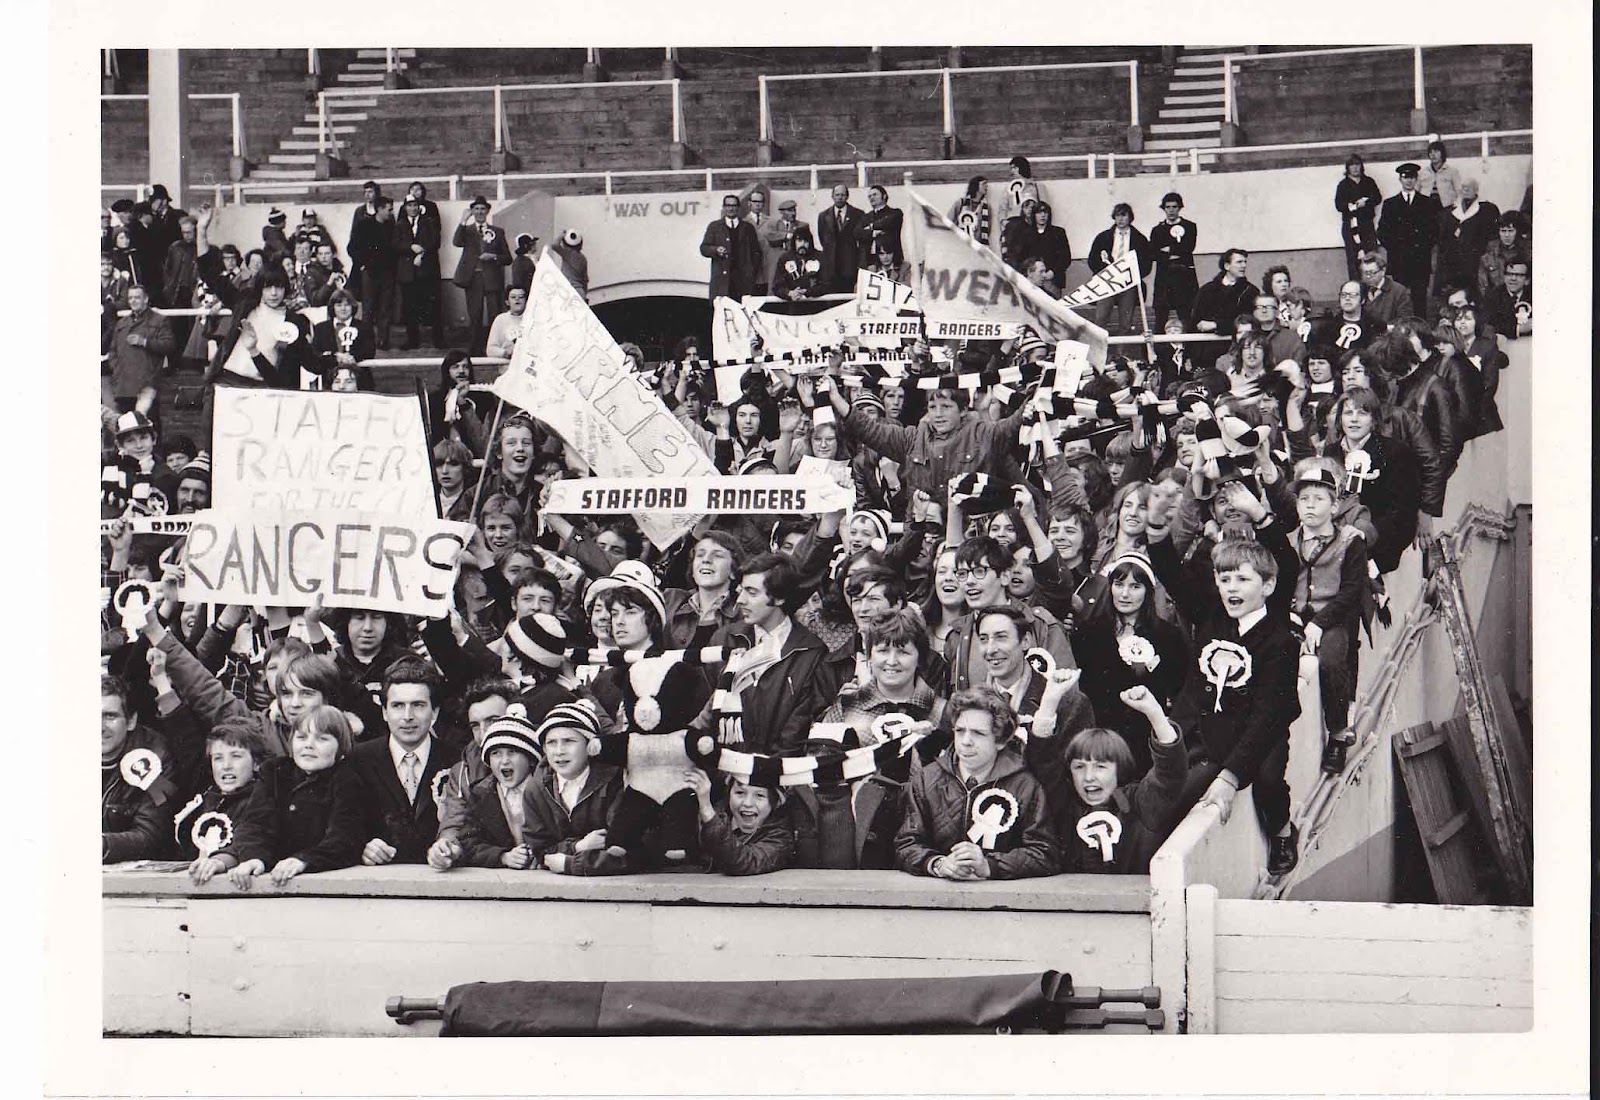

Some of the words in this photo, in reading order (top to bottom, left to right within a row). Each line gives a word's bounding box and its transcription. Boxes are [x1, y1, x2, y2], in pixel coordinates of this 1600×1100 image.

[613, 203, 650, 218] WAY
[660, 201, 701, 216] OUT
[938, 322, 1002, 337] RANGERS
[580, 487, 688, 510] STAFFORD
[706, 488, 807, 511] RANGERS
[184, 522, 465, 602] RANGERS
